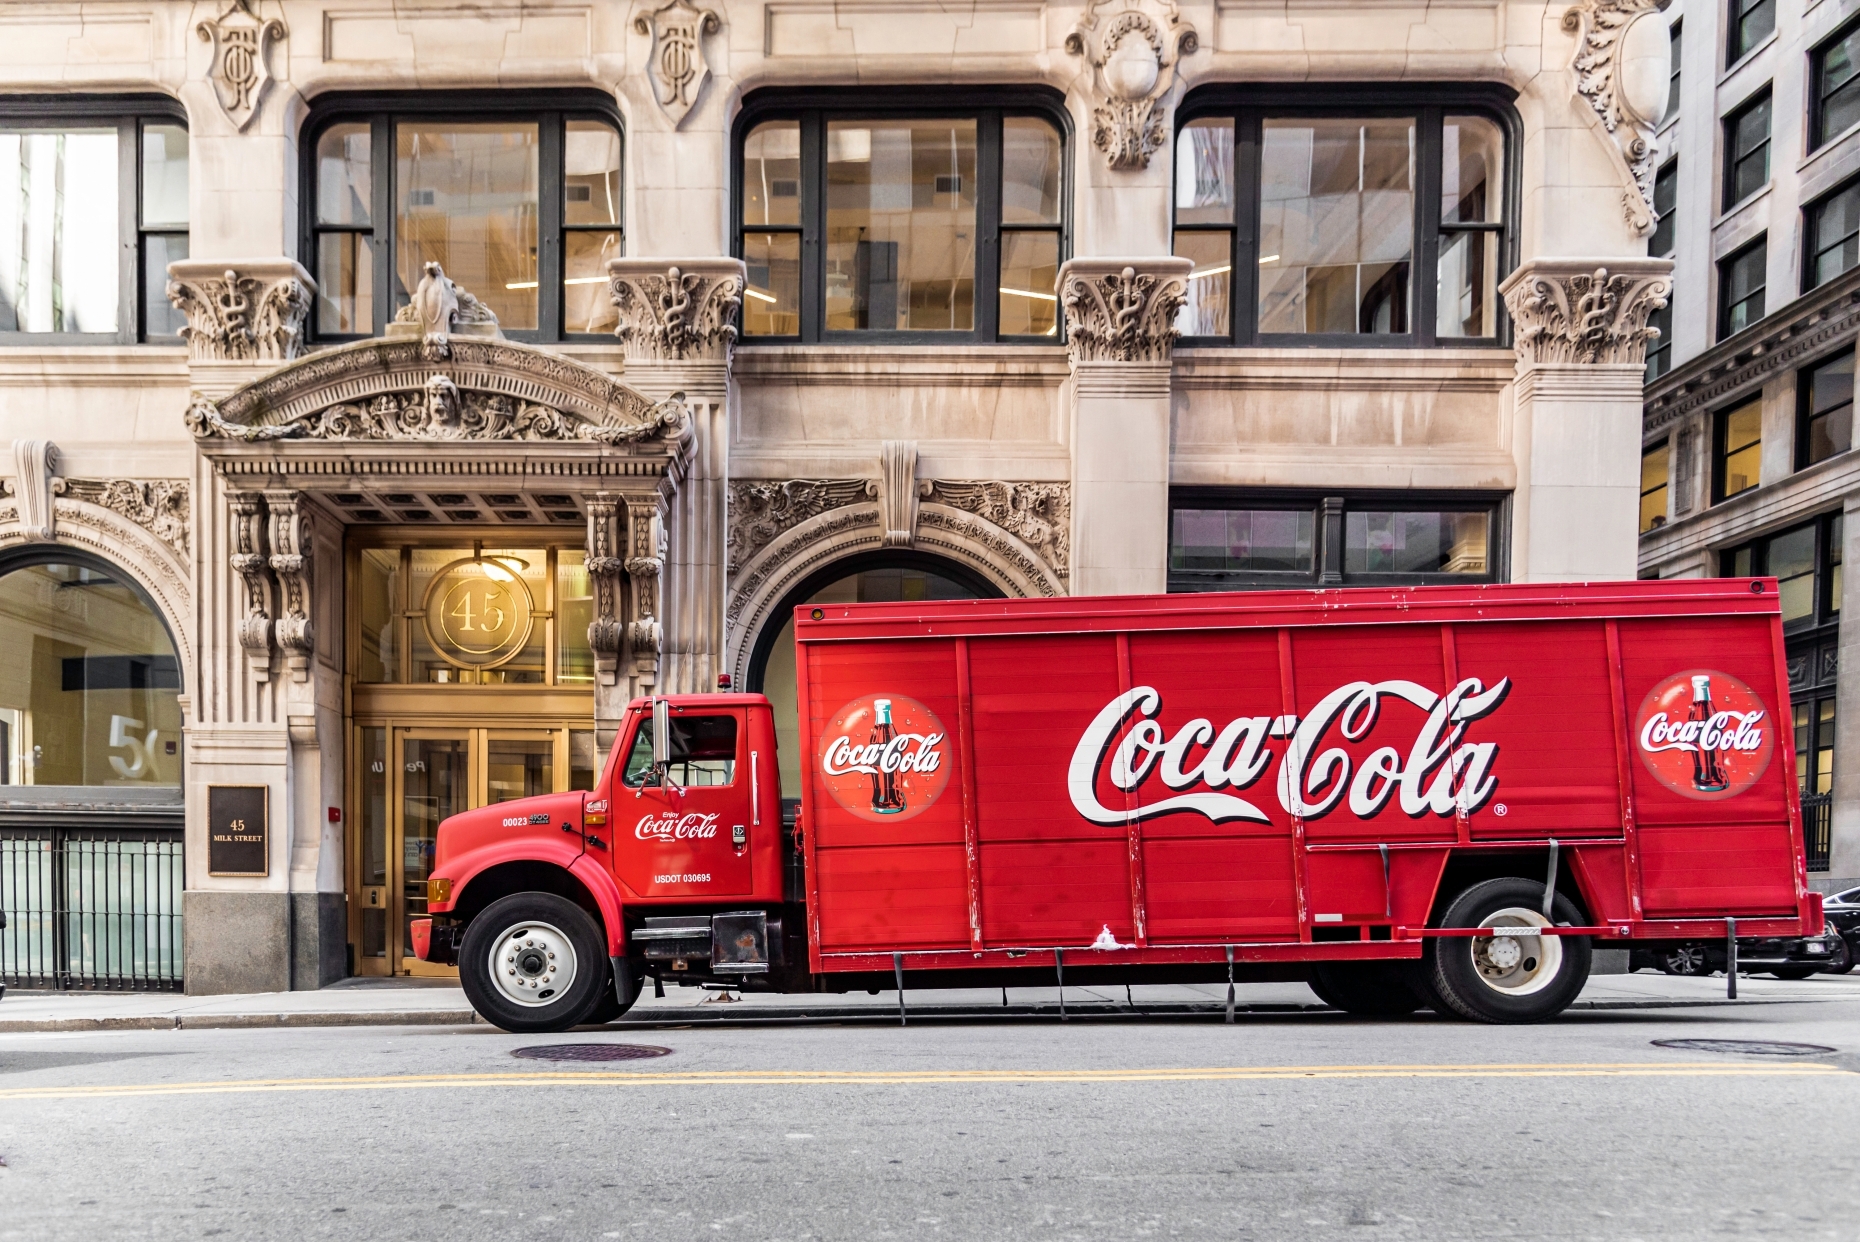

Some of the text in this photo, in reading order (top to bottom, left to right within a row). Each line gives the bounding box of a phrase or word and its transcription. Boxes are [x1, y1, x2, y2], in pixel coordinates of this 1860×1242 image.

[451, 591, 504, 632] 45
[1640, 710, 1764, 752] Coca-Cola
[823, 733, 944, 775] Coca-Cola
[1067, 675, 1510, 826] Coca-Cola
[230, 819, 245, 831] 45
[503, 817, 528, 827] 00023
[662, 811, 680, 820] Enjoy
[634, 813, 721, 840] Coca-Cola
[213, 834, 263, 842] MILK STREET
[654, 873, 711, 884] USDOT 030695
